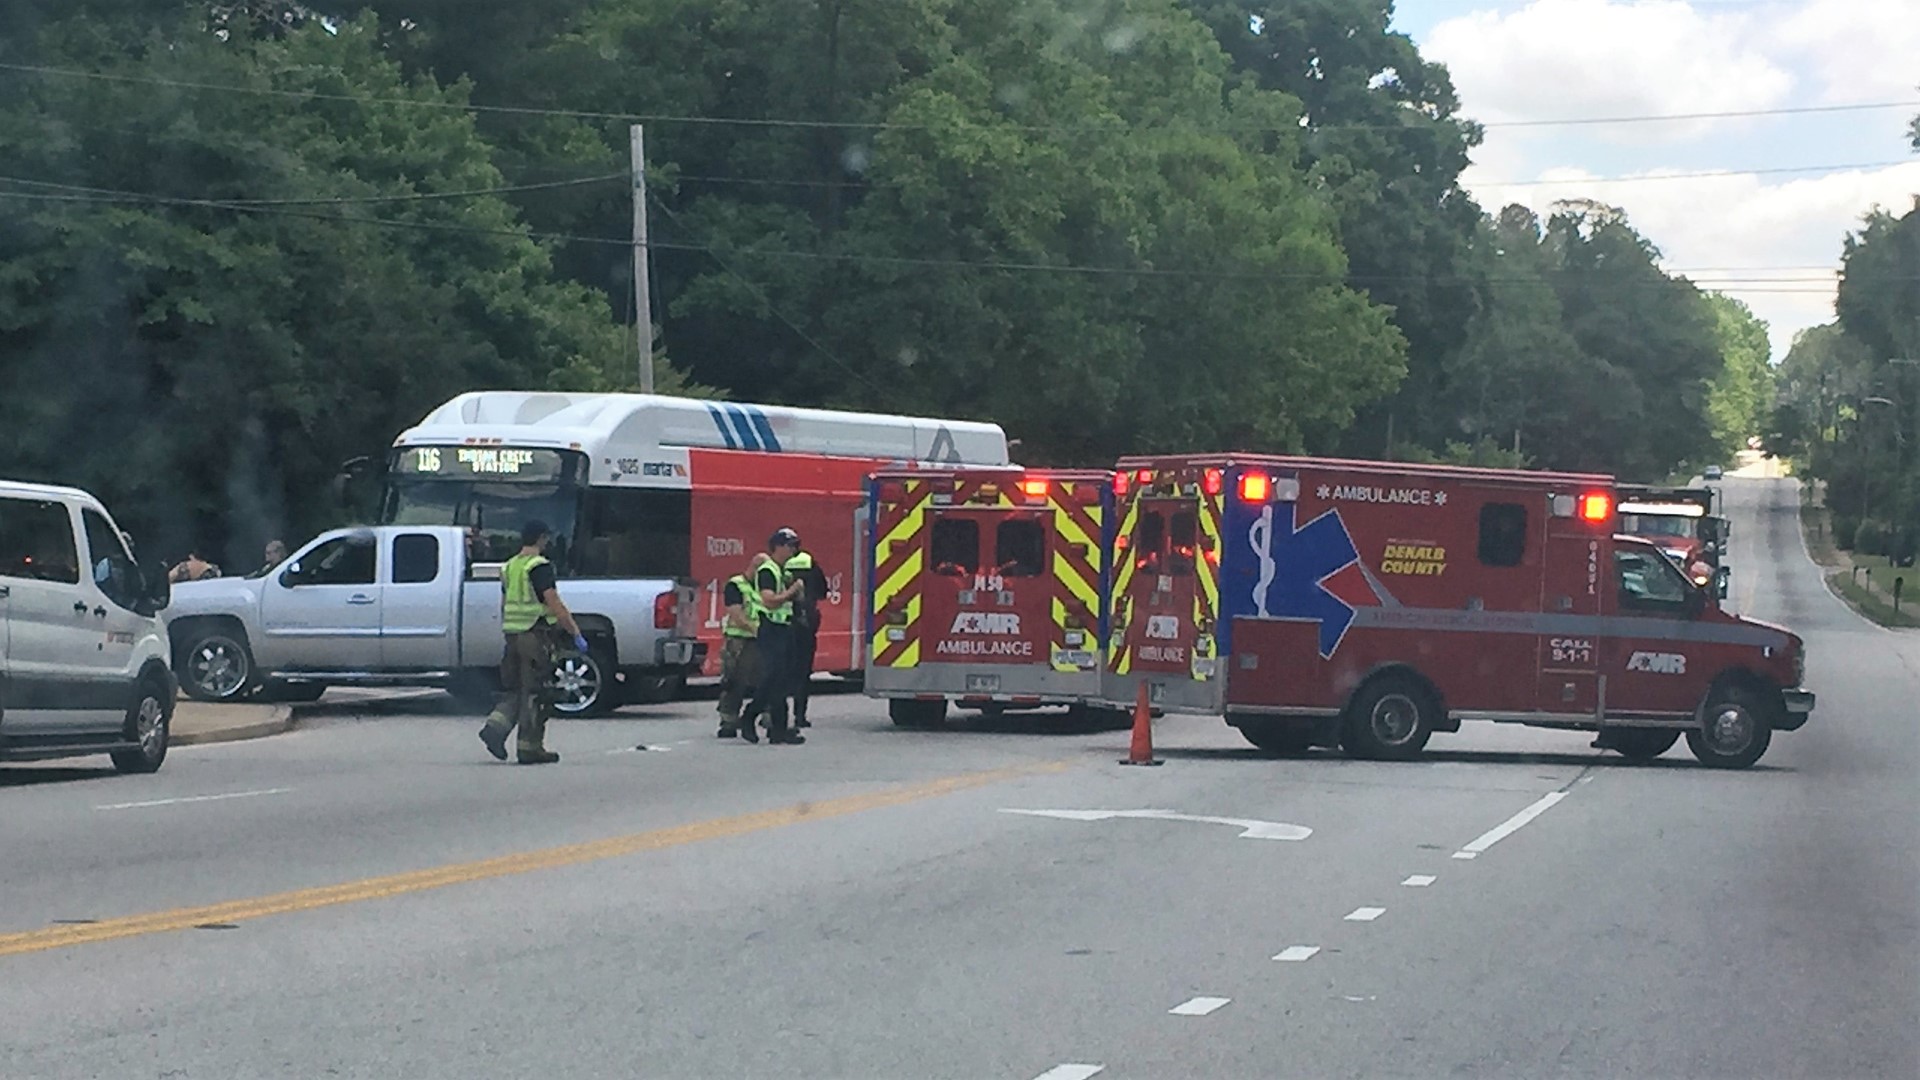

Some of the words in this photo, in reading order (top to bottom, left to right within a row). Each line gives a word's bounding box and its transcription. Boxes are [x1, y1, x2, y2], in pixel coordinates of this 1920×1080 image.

[1332, 485, 1431, 506] AMBULANCE
[1381, 560, 1447, 576] COUNTY
[951, 612, 1020, 634] AMR
[936, 641, 1032, 656] AMBULANCE
[1550, 638, 1593, 649] CALL
[1626, 650, 1687, 674] AMR
